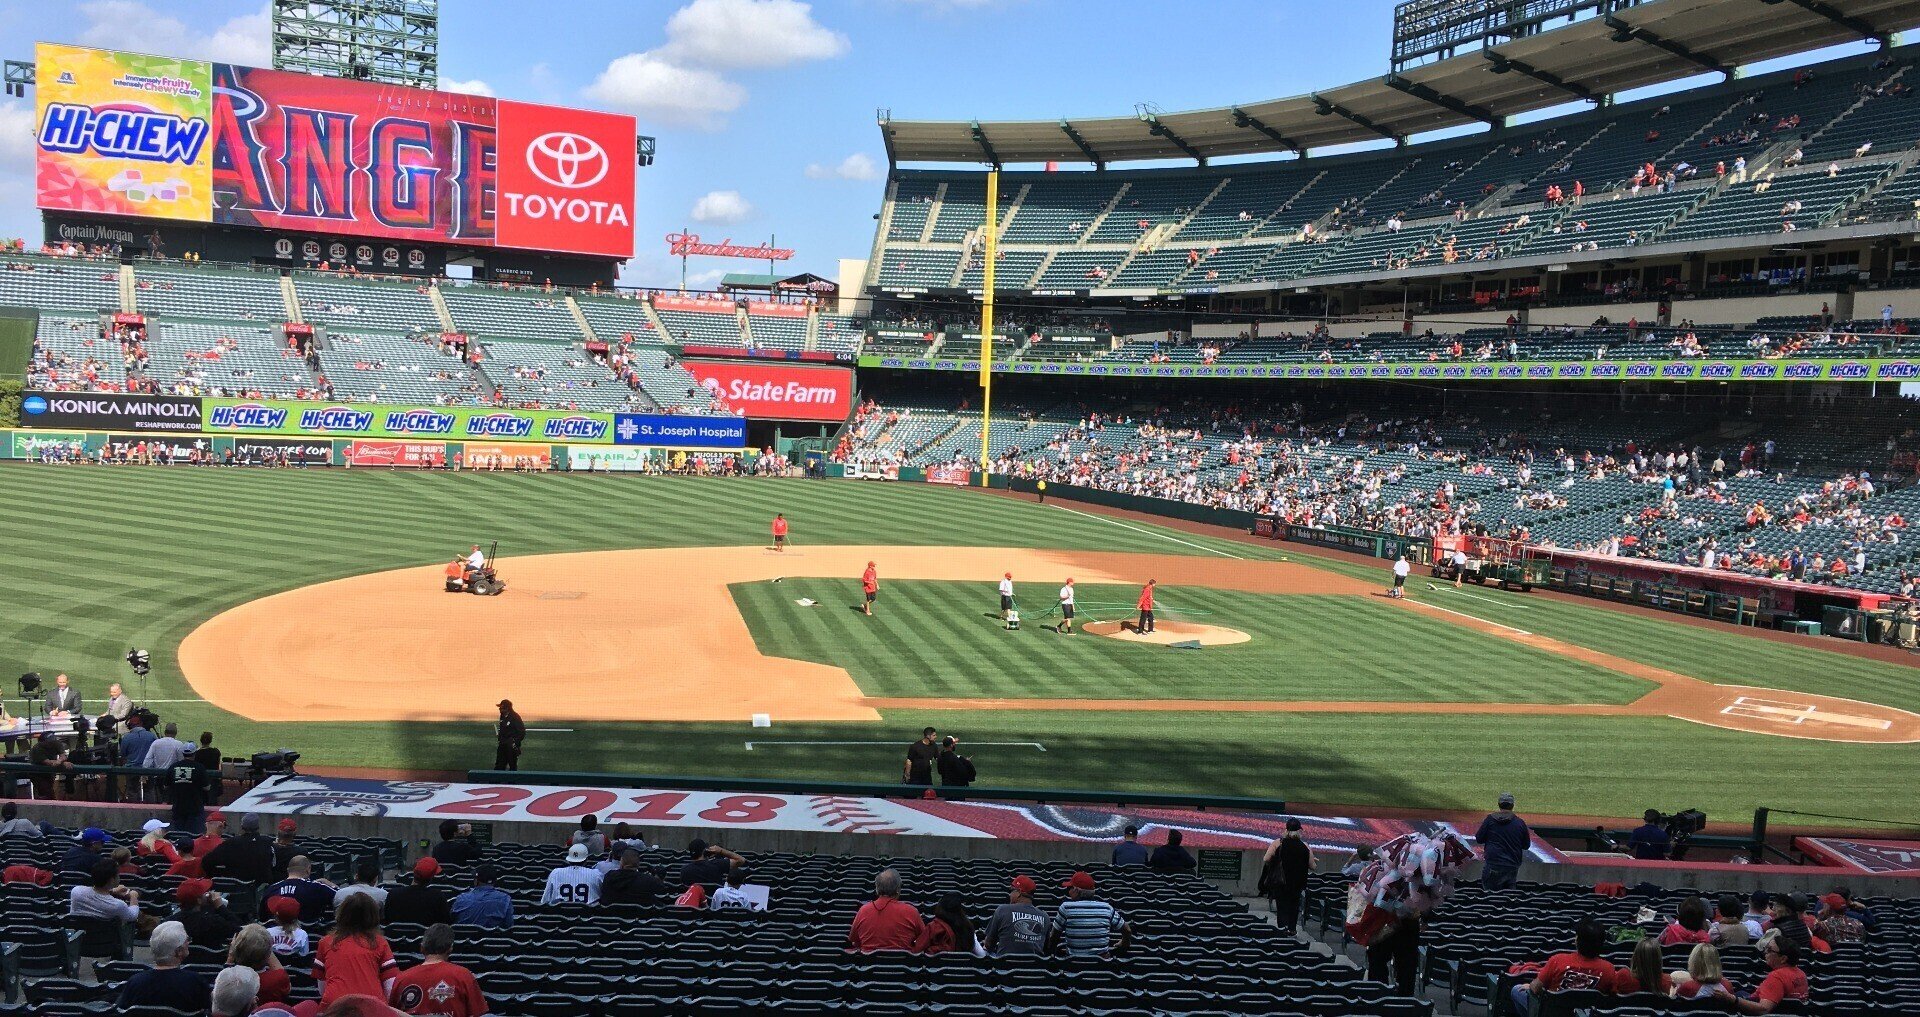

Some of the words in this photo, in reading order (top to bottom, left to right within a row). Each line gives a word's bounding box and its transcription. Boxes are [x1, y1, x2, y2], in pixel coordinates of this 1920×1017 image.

[113, 79, 144, 89] Intensely
[144, 82, 180, 95] Chewy
[179, 88, 201, 97] Candy
[125, 74, 161, 85] Immensely
[162, 77, 191, 89] Fruity
[377, 94, 430, 108] ANGELS
[41, 104, 207, 163] HI-CHEW
[504, 192, 629, 227] TOYOTA
[60, 223, 94, 240] Captain
[95, 225, 133, 243] Morgan
[279, 242, 288, 251] 11
[305, 244, 318, 253] 26
[332, 247, 344, 256] 29
[358, 249, 371, 258] 30
[385, 251, 397, 259] 42
[410, 253, 422, 261] 50
[1626, 365, 1657, 376] HI-CHEW
[1662, 365, 1695, 376] HI-CHEW
[1700, 364, 1735, 376] HI-CHEW
[1741, 364, 1778, 377] HI-CHEW
[1783, 364, 1823, 377] HI-CHEW
[1829, 364, 1871, 377] HI-CHEW
[1877, 364, 1919, 378] HI-CHEW
[51, 399, 122, 415] KONICA
[123, 402, 201, 417] MINOLTA
[135, 421, 202, 430] RESHAPEWORK.COM
[210, 406, 287, 428] HI-CHEW
[300, 409, 373, 430] HI-CHEW
[385, 412, 455, 433] HI-CHEW
[466, 415, 533, 436] HI-CHEW
[544, 418, 607, 439] HI-CHEW
[641, 425, 655, 435] St.
[658, 425, 697, 440] Joseph
[700, 427, 742, 439] Hospital
[405, 445, 421, 453] THIS
[405, 453, 419, 461] FOR
[293, 791, 410, 801] AMERICAN
[426, 786, 788, 823] 2018
[281, 885, 296, 895] RUTH
[559, 883, 589, 902] 99
[1012, 911, 1032, 923] KILLER
